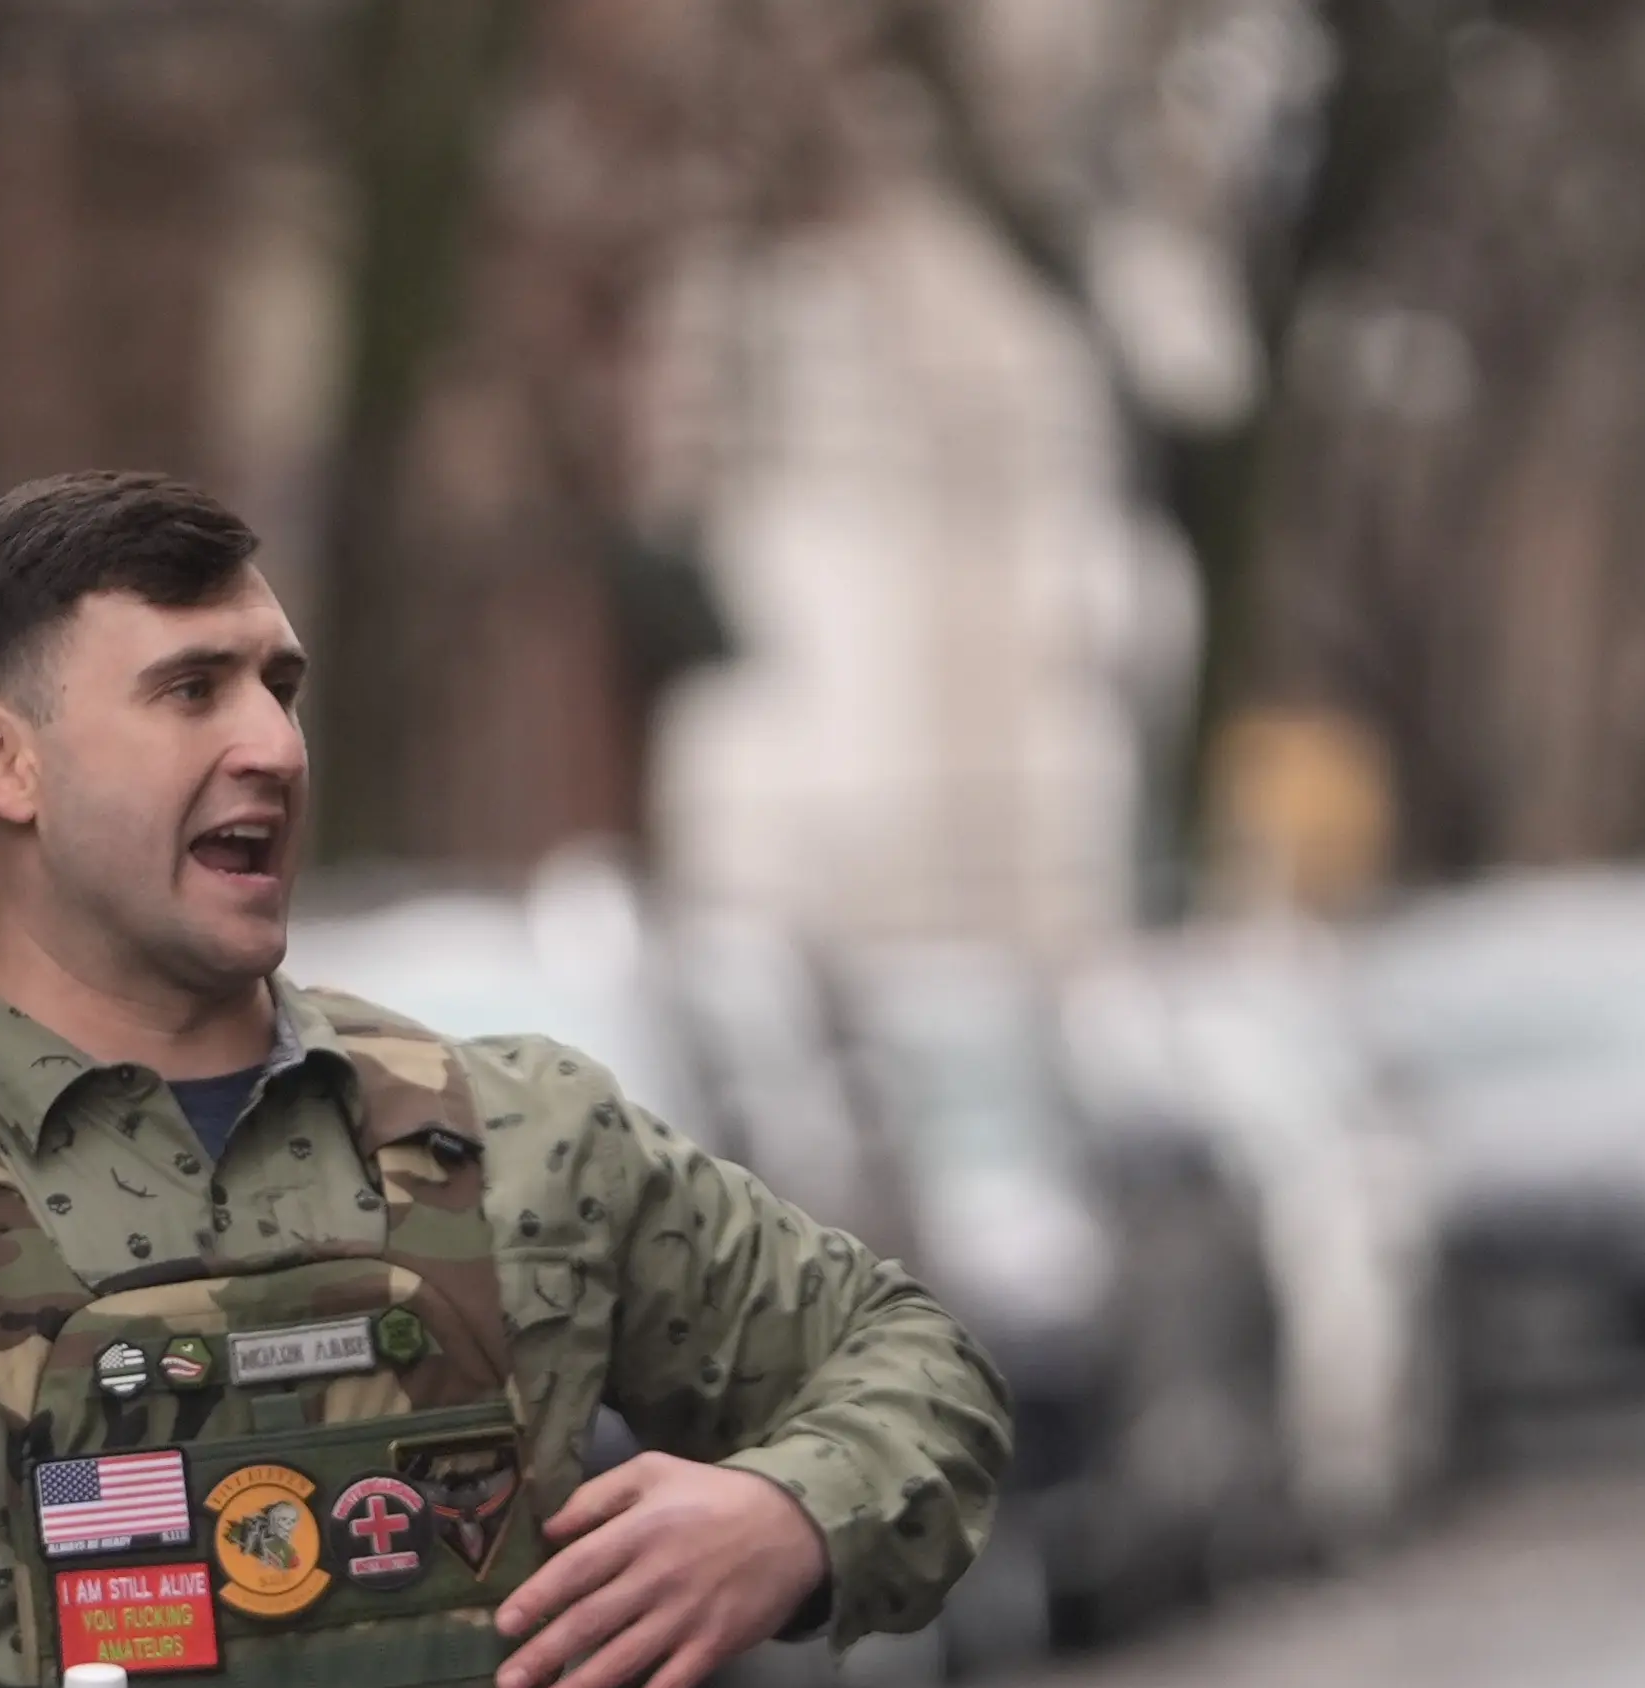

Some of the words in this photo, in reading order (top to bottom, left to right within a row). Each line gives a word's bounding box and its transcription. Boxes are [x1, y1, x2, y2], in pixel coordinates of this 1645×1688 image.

[62, 1579, 70, 1605] I
[76, 1577, 103, 1604] AM
[108, 1574, 154, 1601] STILL
[159, 1571, 207, 1599] ALIVE
[81, 1607, 117, 1632] YOU
[122, 1603, 194, 1629] FUCKING
[98, 1634, 185, 1661] AMATEURS
